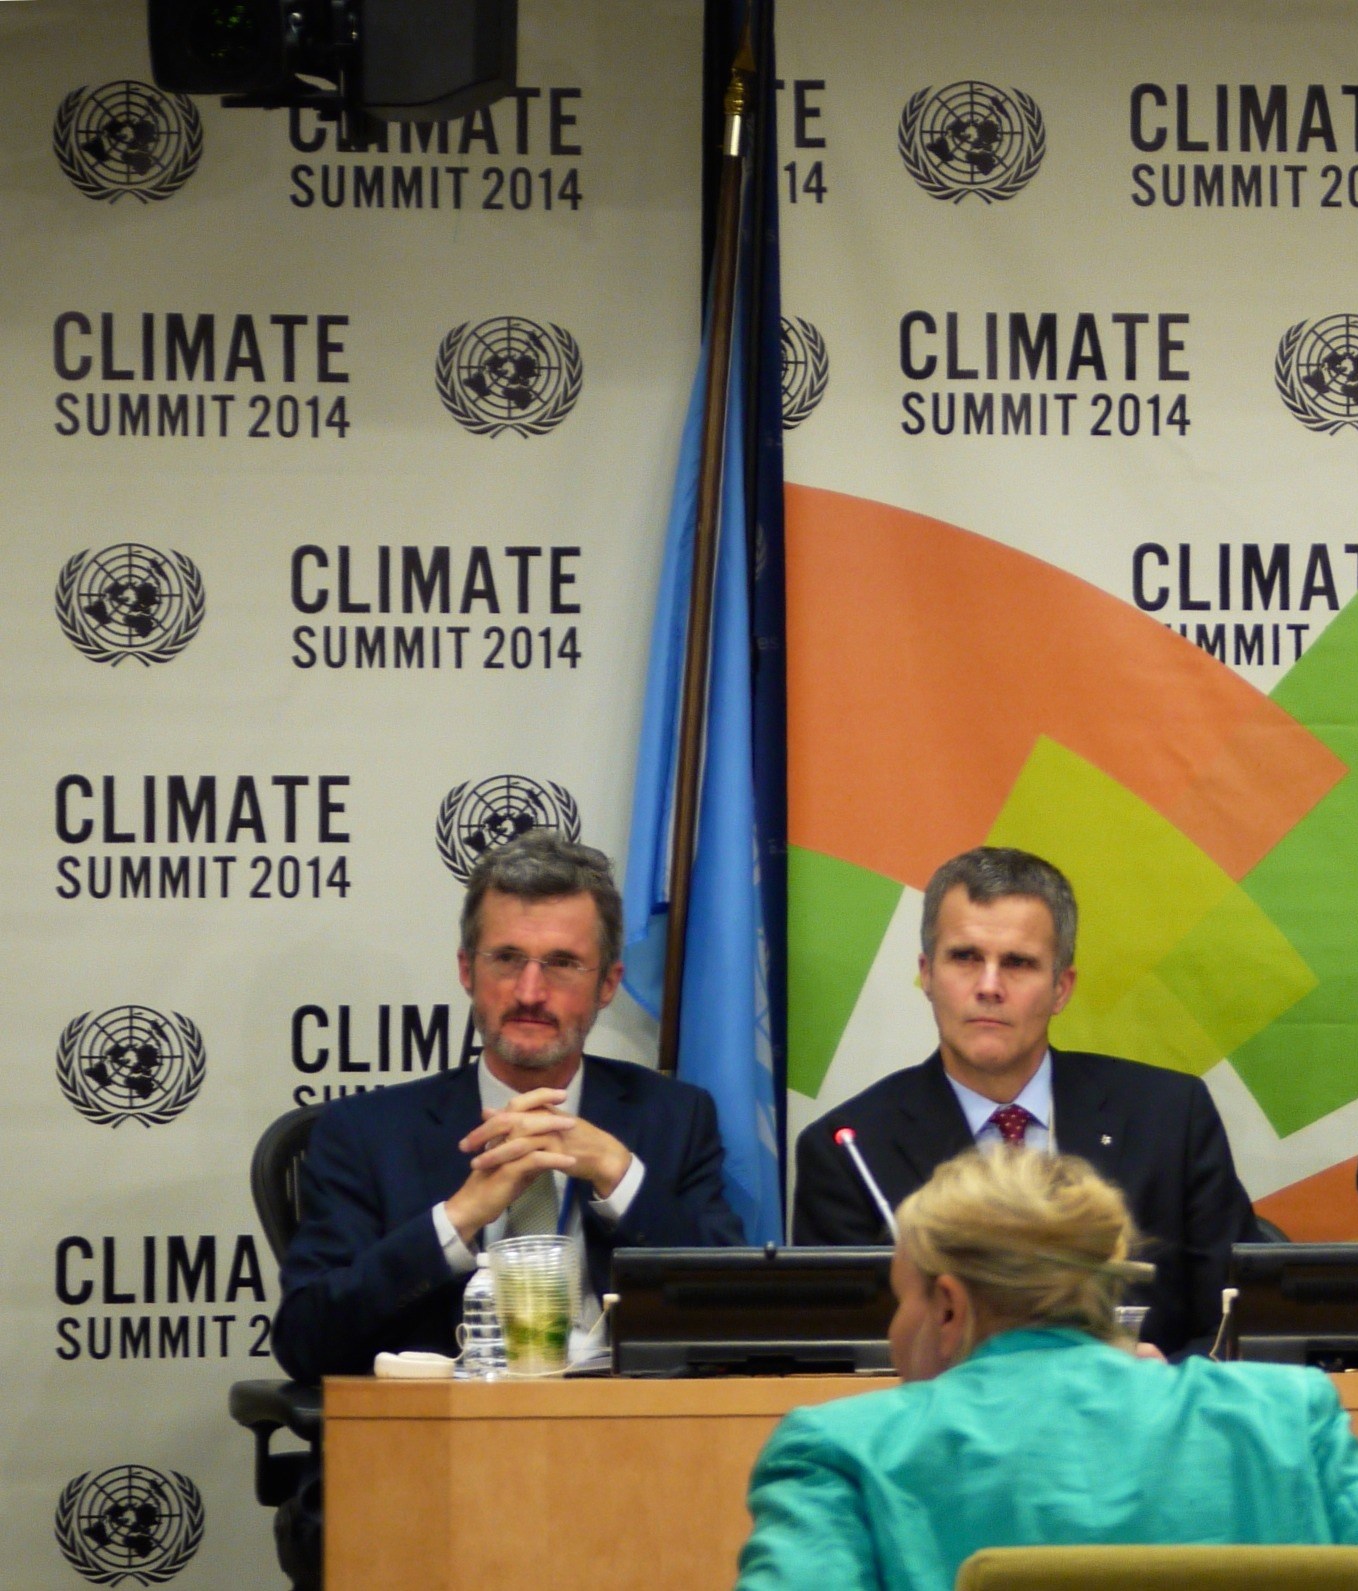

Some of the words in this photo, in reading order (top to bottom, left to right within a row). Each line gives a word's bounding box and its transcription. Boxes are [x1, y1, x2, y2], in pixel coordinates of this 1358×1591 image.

[290, 164, 469, 210] SUMMIT
[483, 164, 583, 210] 2014
[783, 160, 828, 204] 14
[1132, 164, 1307, 208] SUMMIT
[54, 311, 349, 382] CLIMATE
[900, 311, 1189, 380] CLIMATE
[55, 393, 235, 438] SUMMIT
[249, 393, 350, 438] 2014
[902, 392, 1077, 436] SUMMIT
[1091, 392, 1190, 436] 2014
[292, 545, 580, 614] CLIMATE
[293, 626, 470, 669] SUMMIT
[484, 626, 581, 669] 2014
[1164, 623, 1309, 666] MMIT
[56, 775, 349, 844] CLIMATE
[57, 856, 236, 899] SUMMIT
[250, 856, 350, 899] 2014
[55, 1235, 266, 1305] CLIMA
[56, 1315, 236, 1360] SUMMIT
